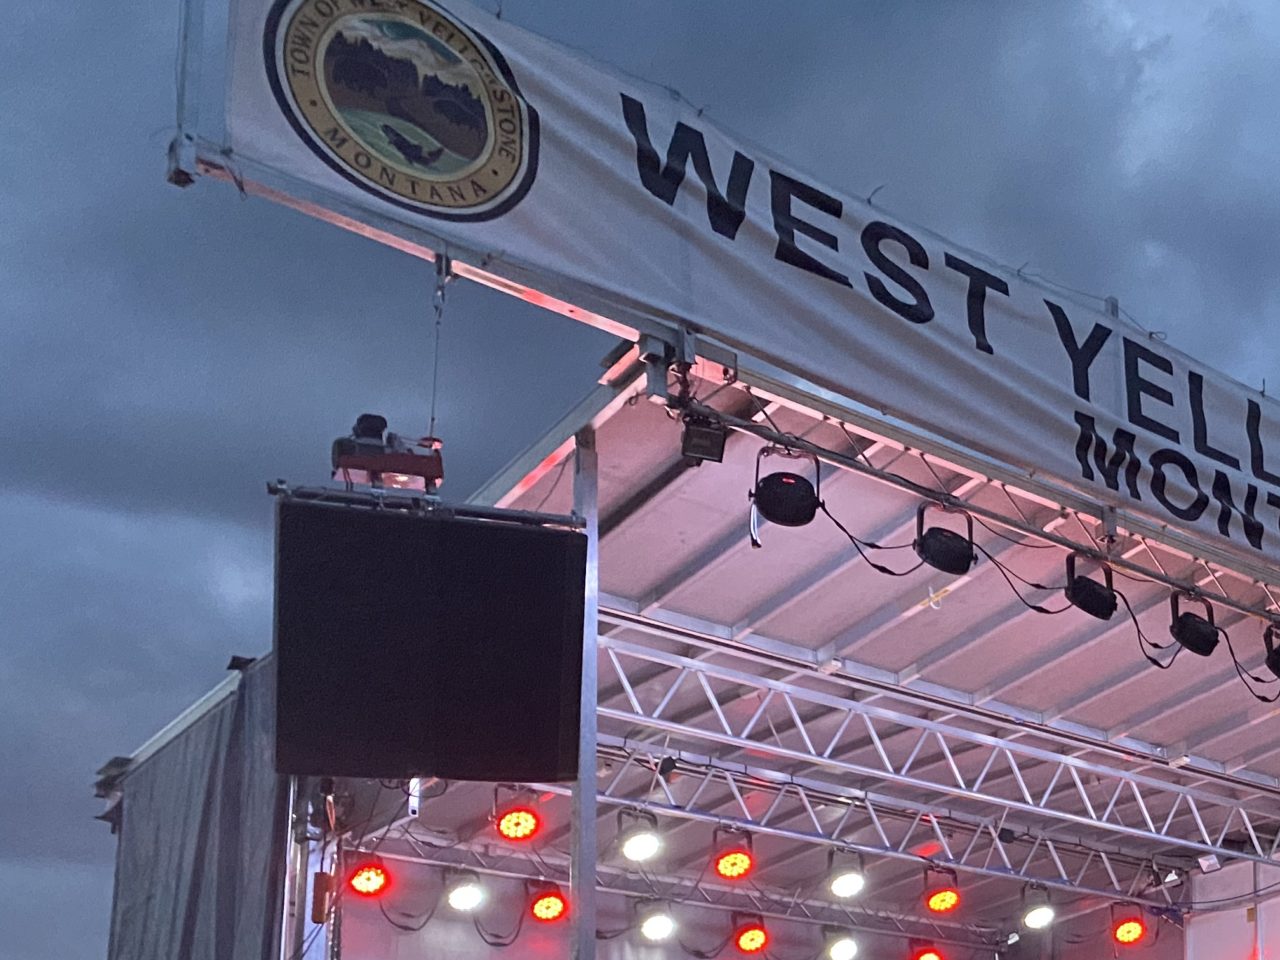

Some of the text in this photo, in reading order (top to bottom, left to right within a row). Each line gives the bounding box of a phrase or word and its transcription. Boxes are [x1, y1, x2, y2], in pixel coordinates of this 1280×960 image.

[290, 17, 319, 77] TOWN
[324, 127, 487, 202] MONTANA
[620, 92, 1010, 355] WEST
